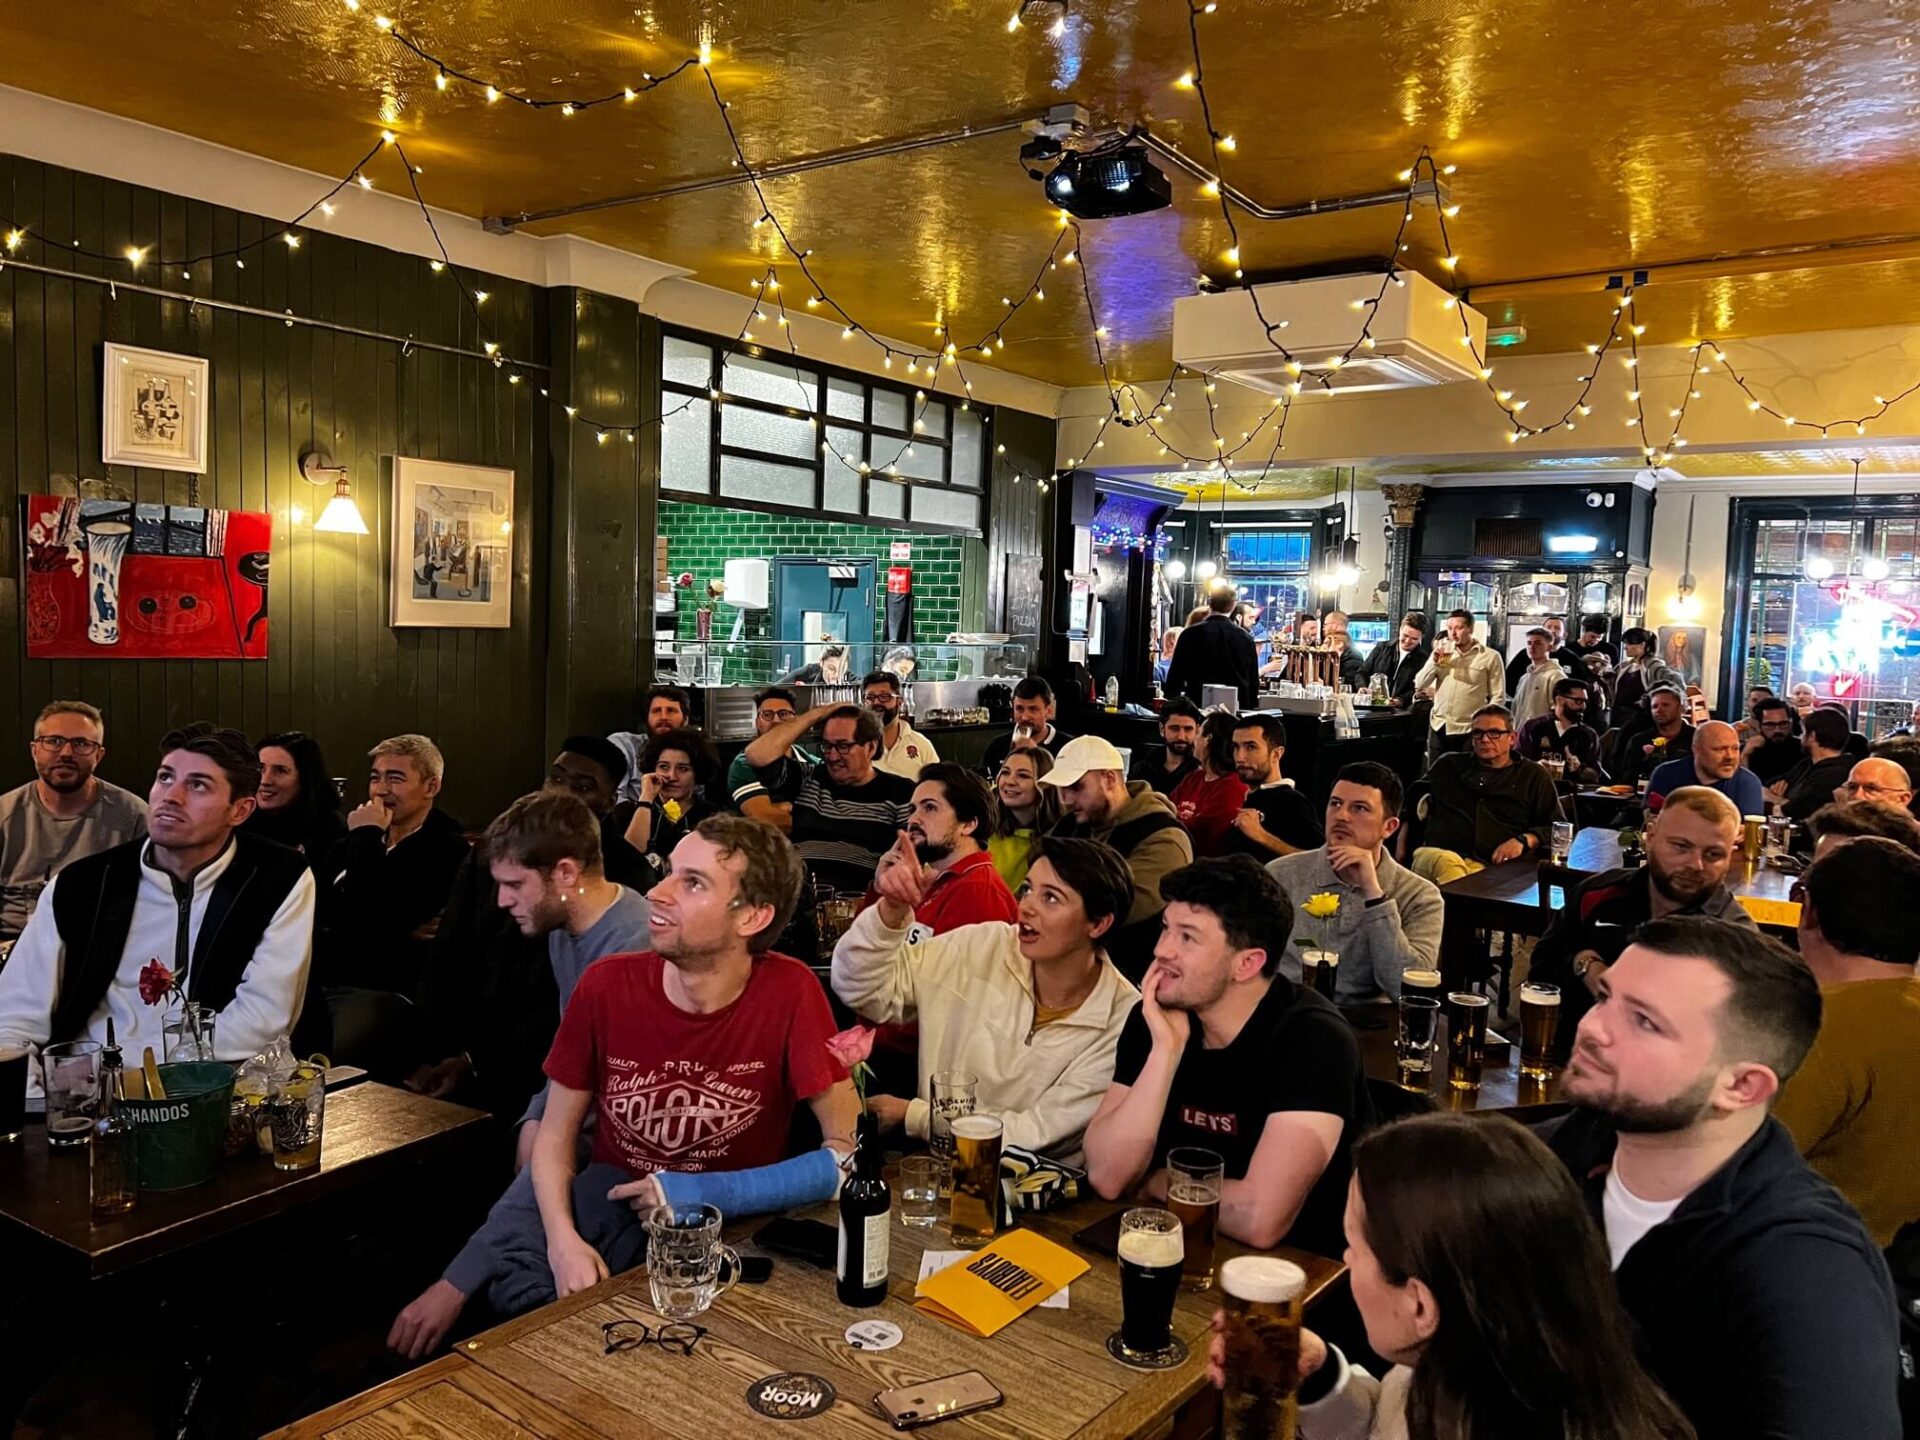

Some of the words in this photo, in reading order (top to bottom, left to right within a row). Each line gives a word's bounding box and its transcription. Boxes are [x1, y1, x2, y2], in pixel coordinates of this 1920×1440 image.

[606, 1070, 667, 1093] Ralph
[701, 1071, 760, 1101] Lauren
[127, 1103, 190, 1124] HANDOS
[688, 1145, 730, 1158] MARK
[760, 1385, 822, 1408] MOOR
